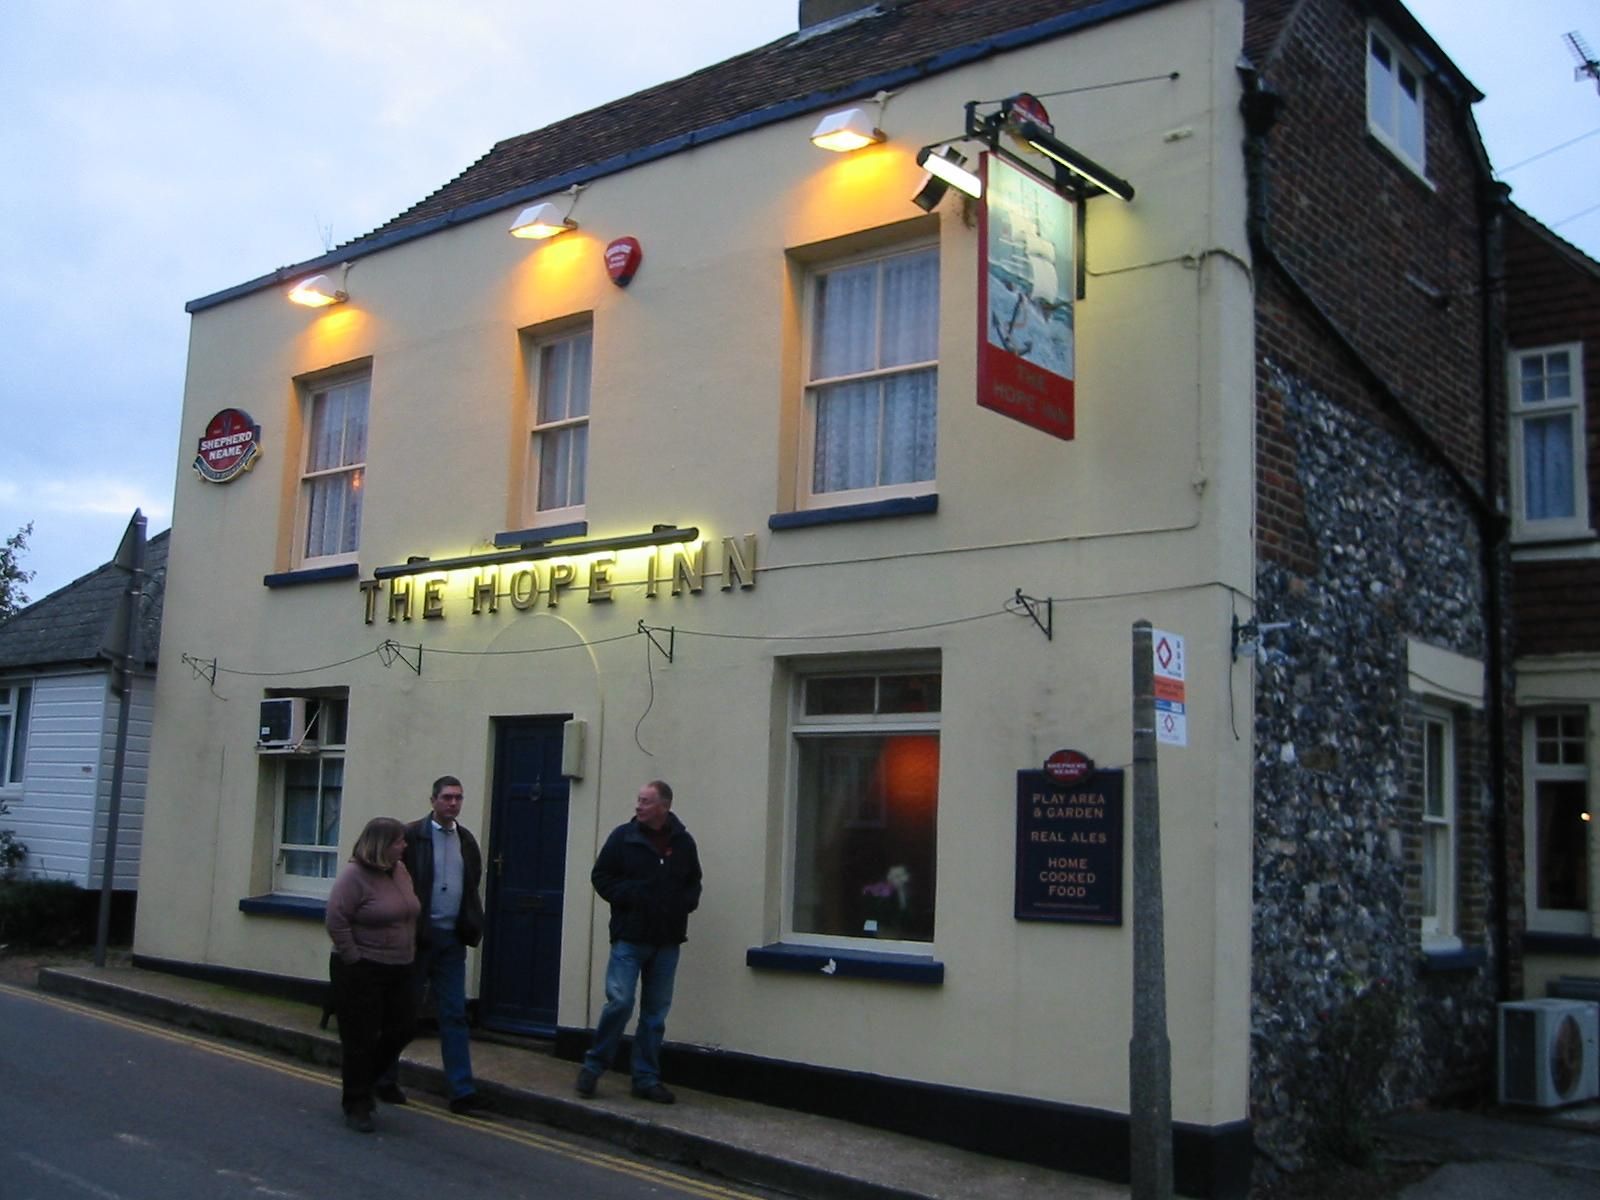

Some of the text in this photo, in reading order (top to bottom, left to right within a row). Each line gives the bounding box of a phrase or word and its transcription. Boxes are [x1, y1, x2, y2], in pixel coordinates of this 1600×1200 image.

[201, 431, 252, 450] SHEPHERD
[209, 445, 242, 460] NEAME
[360, 532, 757, 624] THE HOPE INN
[1033, 793, 1105, 804] PLAY AREA
[1047, 807, 1104, 819] GARDEN
[1031, 831, 1107, 844] REAL ALES
[1048, 858, 1088, 869] HOME
[1039, 872, 1096, 884] COOKED
[1048, 885, 1086, 897] FOOD
